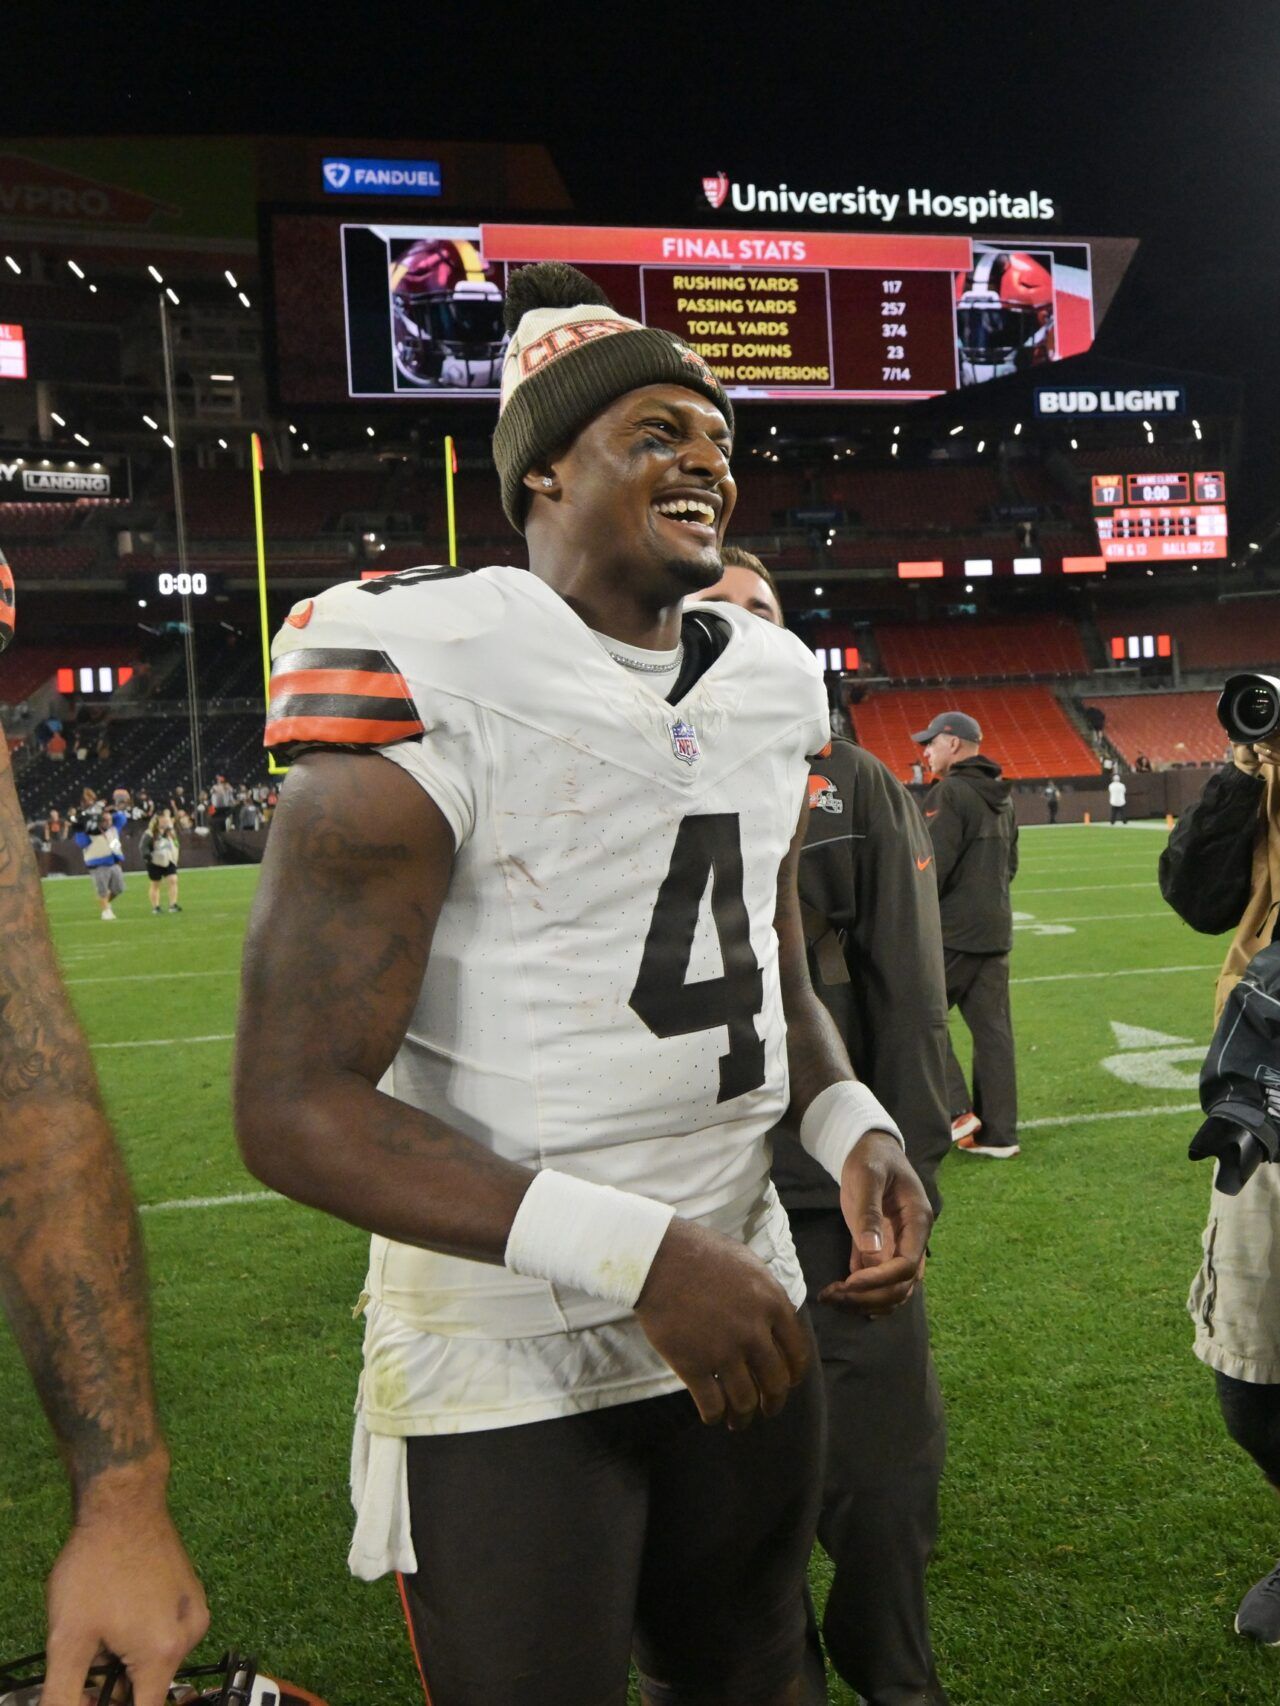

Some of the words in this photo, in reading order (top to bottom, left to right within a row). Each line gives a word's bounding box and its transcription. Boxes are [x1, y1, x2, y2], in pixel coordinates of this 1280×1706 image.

[354, 169, 440, 186] FANDUEL
[731, 183, 899, 222] University
[908, 188, 1055, 224] Hospitals
[662, 237, 735, 260] FINAL
[739, 239, 806, 261] STATS
[673, 276, 746, 291] RUSHING
[748, 278, 799, 292] YARDS
[882, 280, 902, 294] 117
[677, 298, 744, 313] PASSING
[746, 300, 797, 314] YARDS
[881, 302, 906, 316] 257
[687, 321, 736, 336] TOTAL
[738, 322, 789, 336] YARDS
[882, 324, 907, 338] 374
[732, 344, 792, 358] DOWNS
[886, 346, 905, 360] 23
[736, 366, 830, 381] CONVERSIONS
[881, 367, 912, 381] 7/14
[1039, 391, 1099, 413] BUD
[1100, 390, 1180, 412] LIGHT
[28, 475, 105, 492] LANDING
[1102, 487, 1115, 503] 17
[1143, 485, 1170, 501] 0:00
[159, 573, 207, 595] 0:00
[676, 737, 698, 760] NFL
[628, 812, 767, 1104] 4
